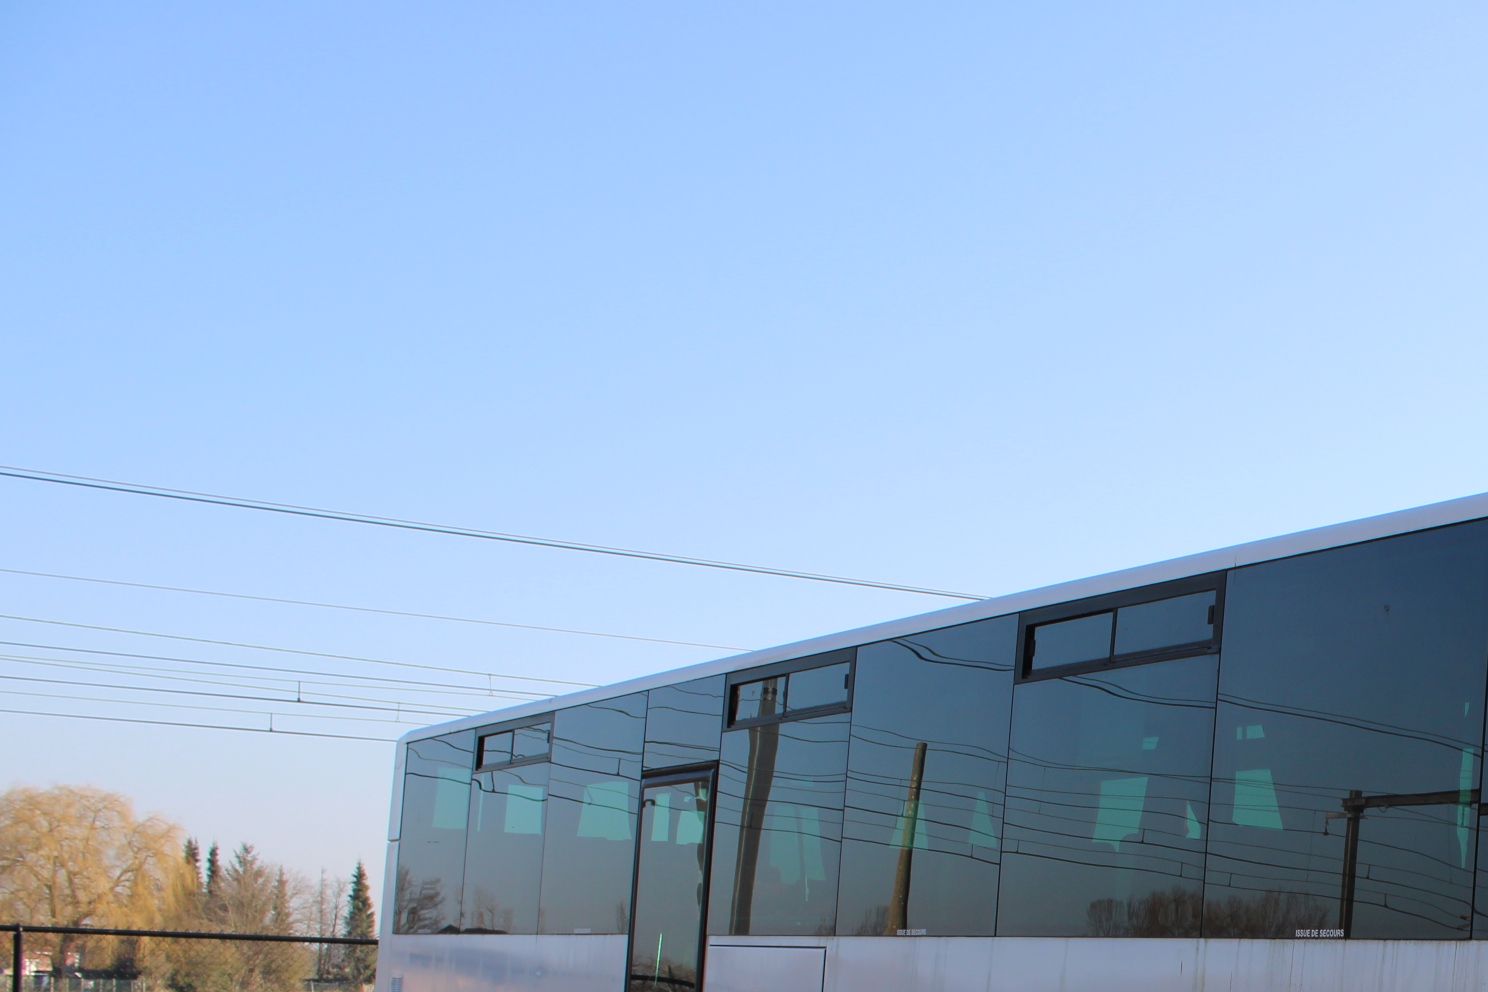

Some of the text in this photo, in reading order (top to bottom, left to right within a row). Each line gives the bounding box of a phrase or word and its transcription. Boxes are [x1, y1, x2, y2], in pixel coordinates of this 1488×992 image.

[1295, 929, 1344, 938] ISSUE DE SECOURS
